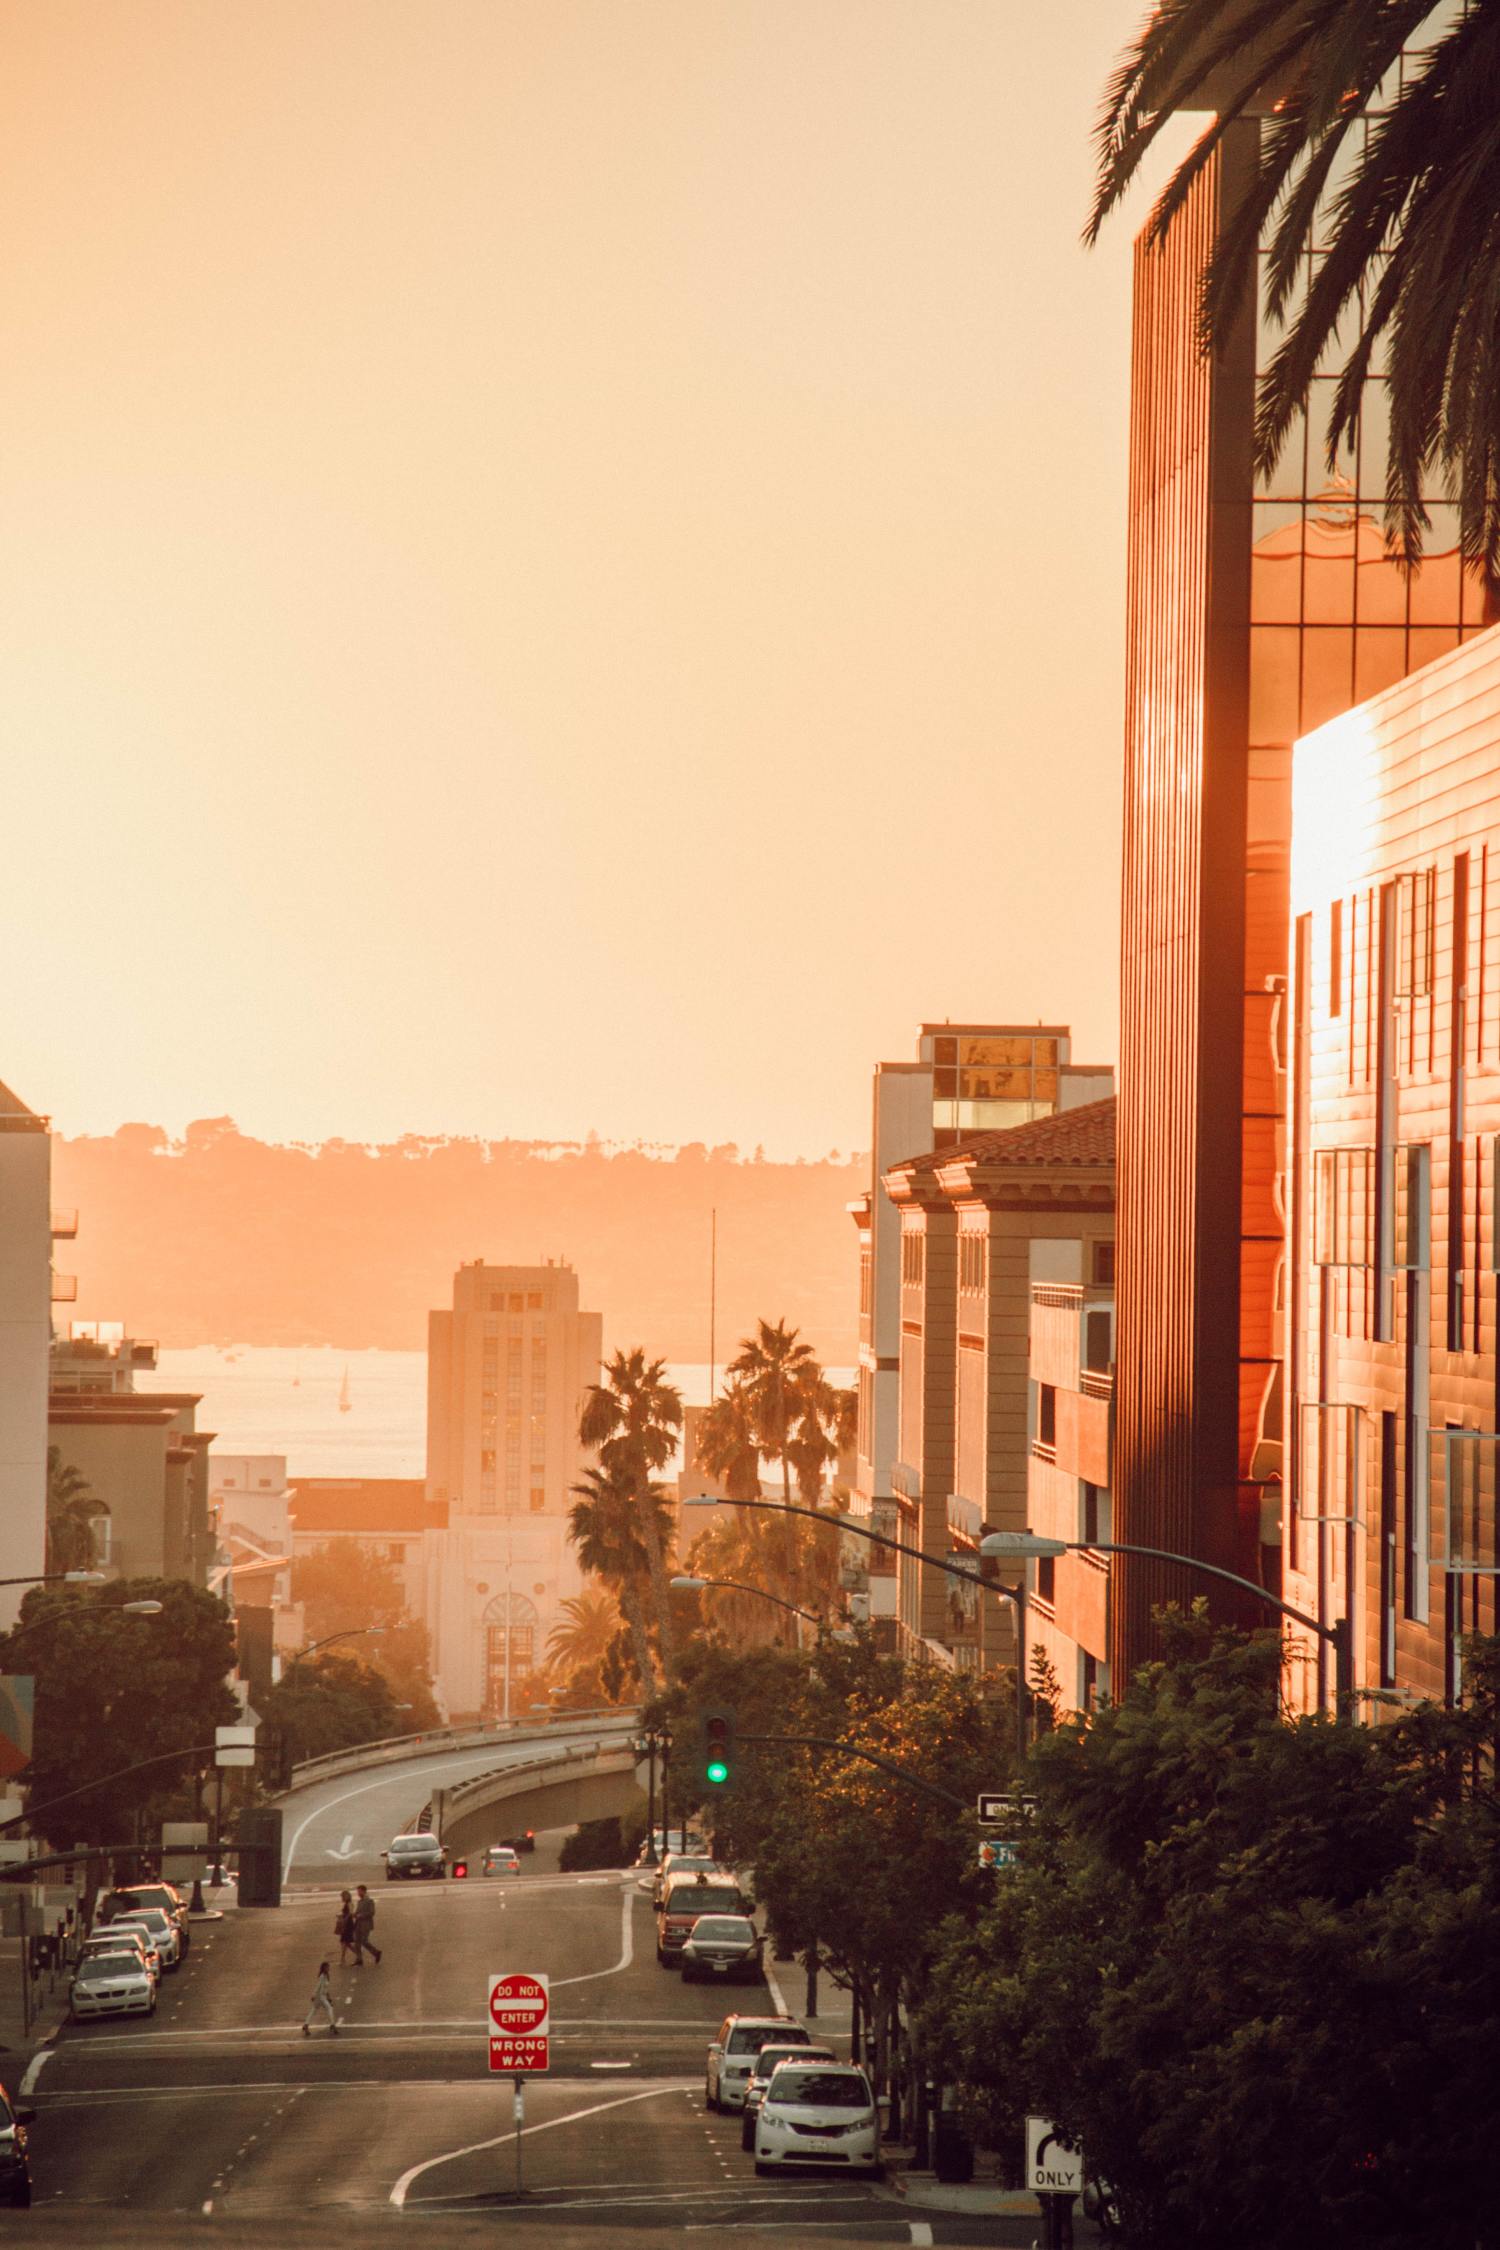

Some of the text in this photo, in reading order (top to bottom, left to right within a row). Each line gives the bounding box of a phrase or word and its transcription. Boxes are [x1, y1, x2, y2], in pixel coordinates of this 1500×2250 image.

[498, 1986, 540, 1996] DO NOT
[501, 2013, 536, 2023] ENTER
[491, 2041, 546, 2051] WRONG
[502, 2056, 535, 2066] WAY
[1036, 2171, 1074, 2186] ONLY
